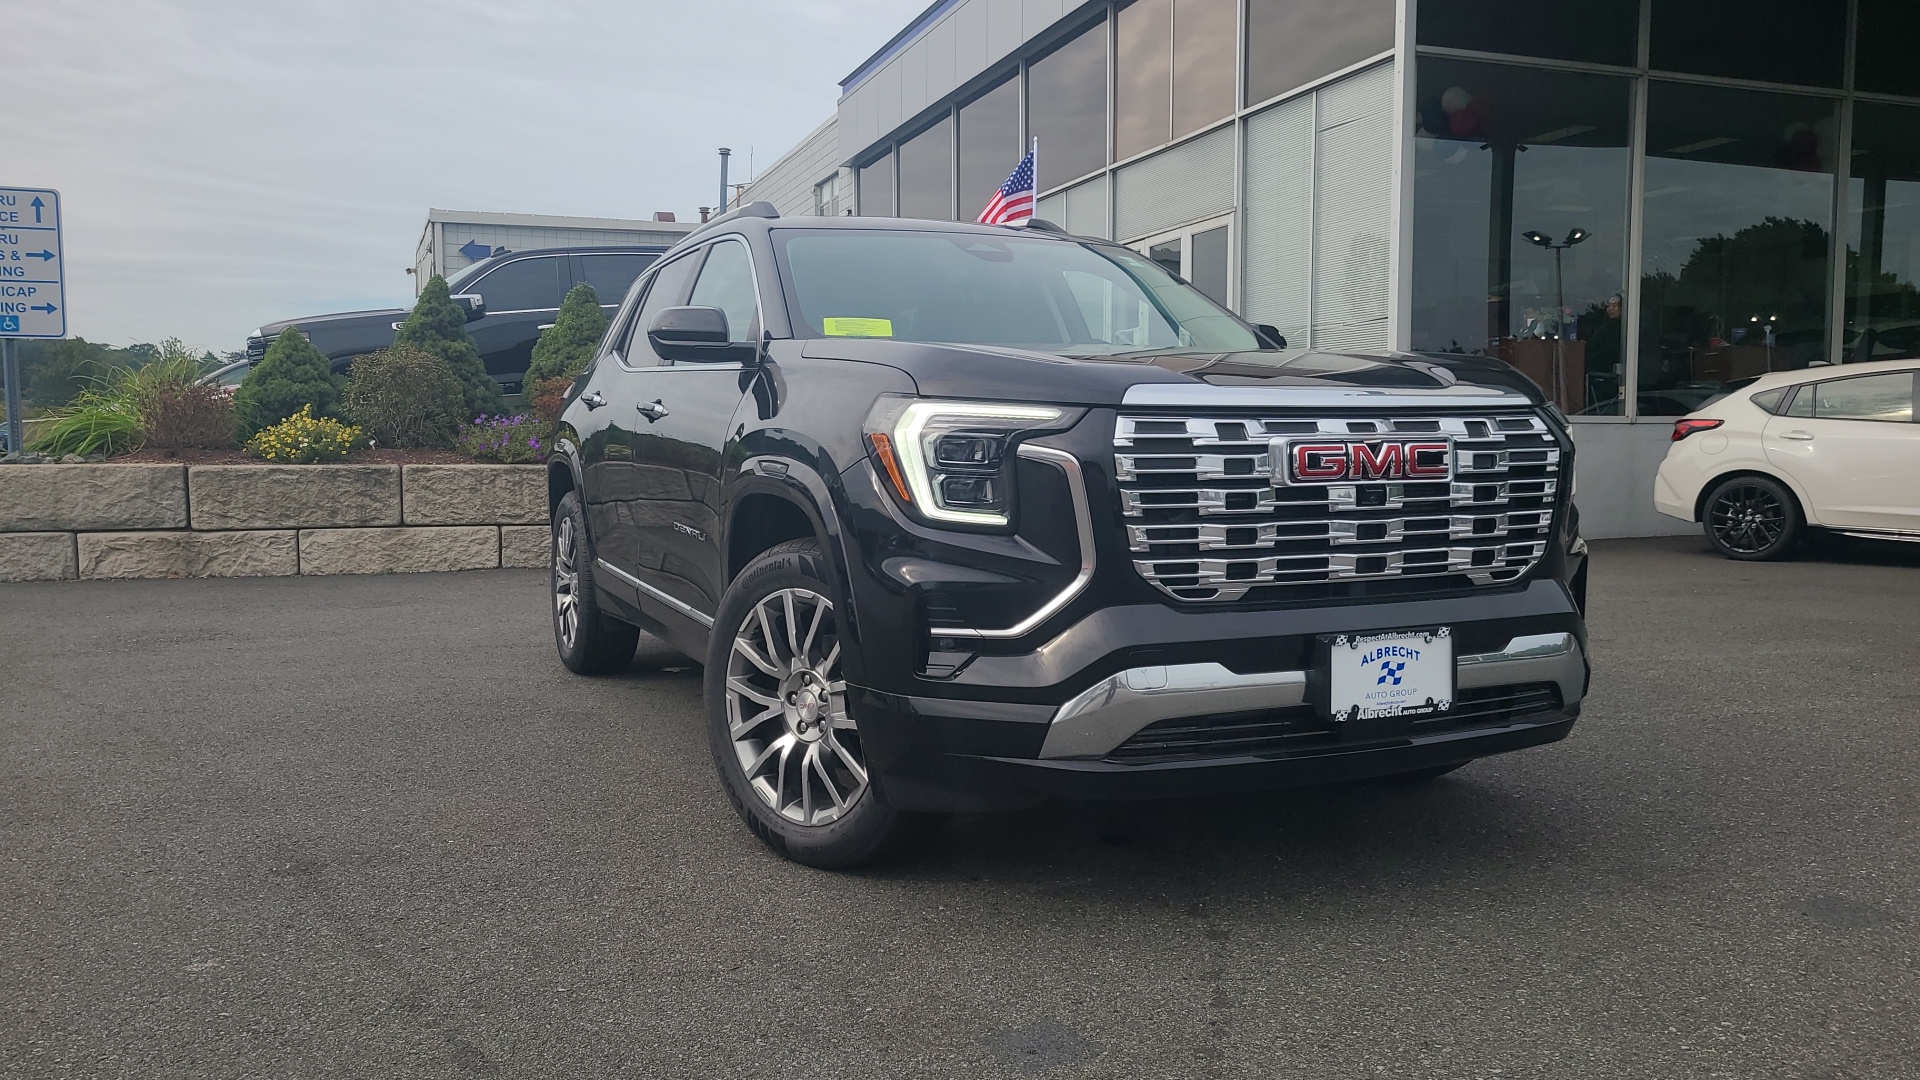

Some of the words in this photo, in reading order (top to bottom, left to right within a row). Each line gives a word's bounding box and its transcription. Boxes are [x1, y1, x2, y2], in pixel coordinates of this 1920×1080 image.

[0, 211, 19, 222] CE
[10, 250, 21, 262] &
[1, 286, 37, 298] ICAP
[0, 302, 27, 313] ING
[1293, 442, 1450, 481] GMC
[673, 521, 707, 542] DENALI
[742, 558, 785, 589] Continental
[1355, 631, 1430, 643] RespectAtAlbrecht.com
[1361, 646, 1420, 667] ALBRECHT
[1365, 691, 1388, 700] AUTO
[1389, 688, 1418, 698] GROUP
[1357, 705, 1403, 720] Albrecht
[1416, 707, 1434, 715] GROUP
